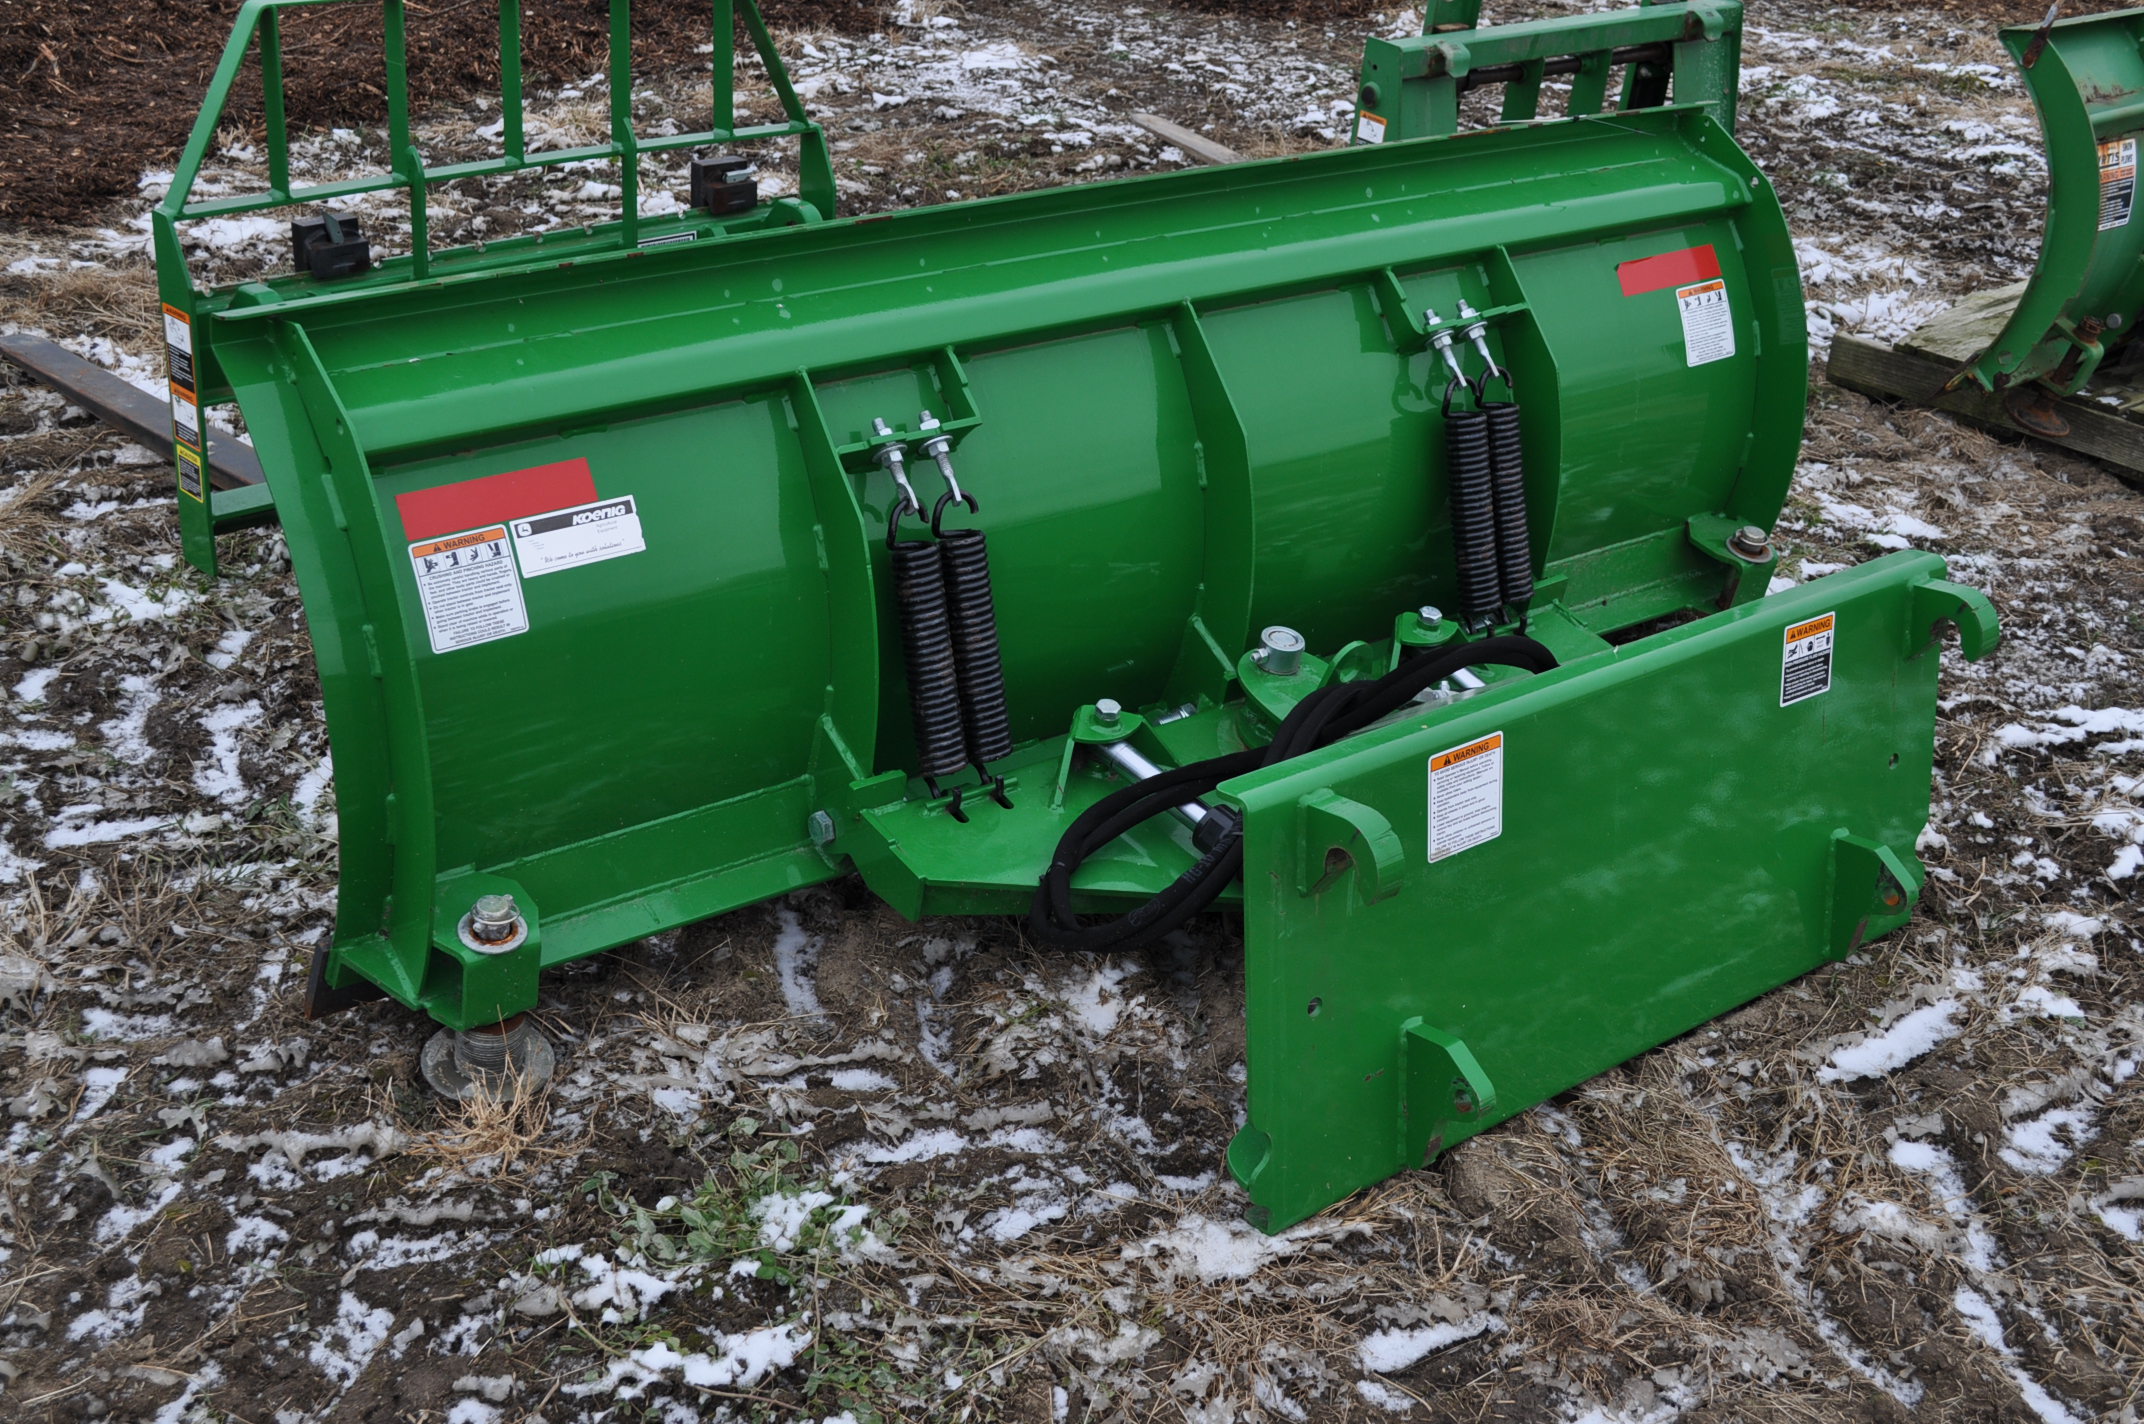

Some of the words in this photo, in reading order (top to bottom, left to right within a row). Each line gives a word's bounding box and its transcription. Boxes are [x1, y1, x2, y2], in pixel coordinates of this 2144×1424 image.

[2099, 152, 2119, 164] RTIS
[443, 534, 485, 549] WARNING
[1797, 619, 1831, 636] WARNING
[1453, 743, 1490, 761] WARNING
